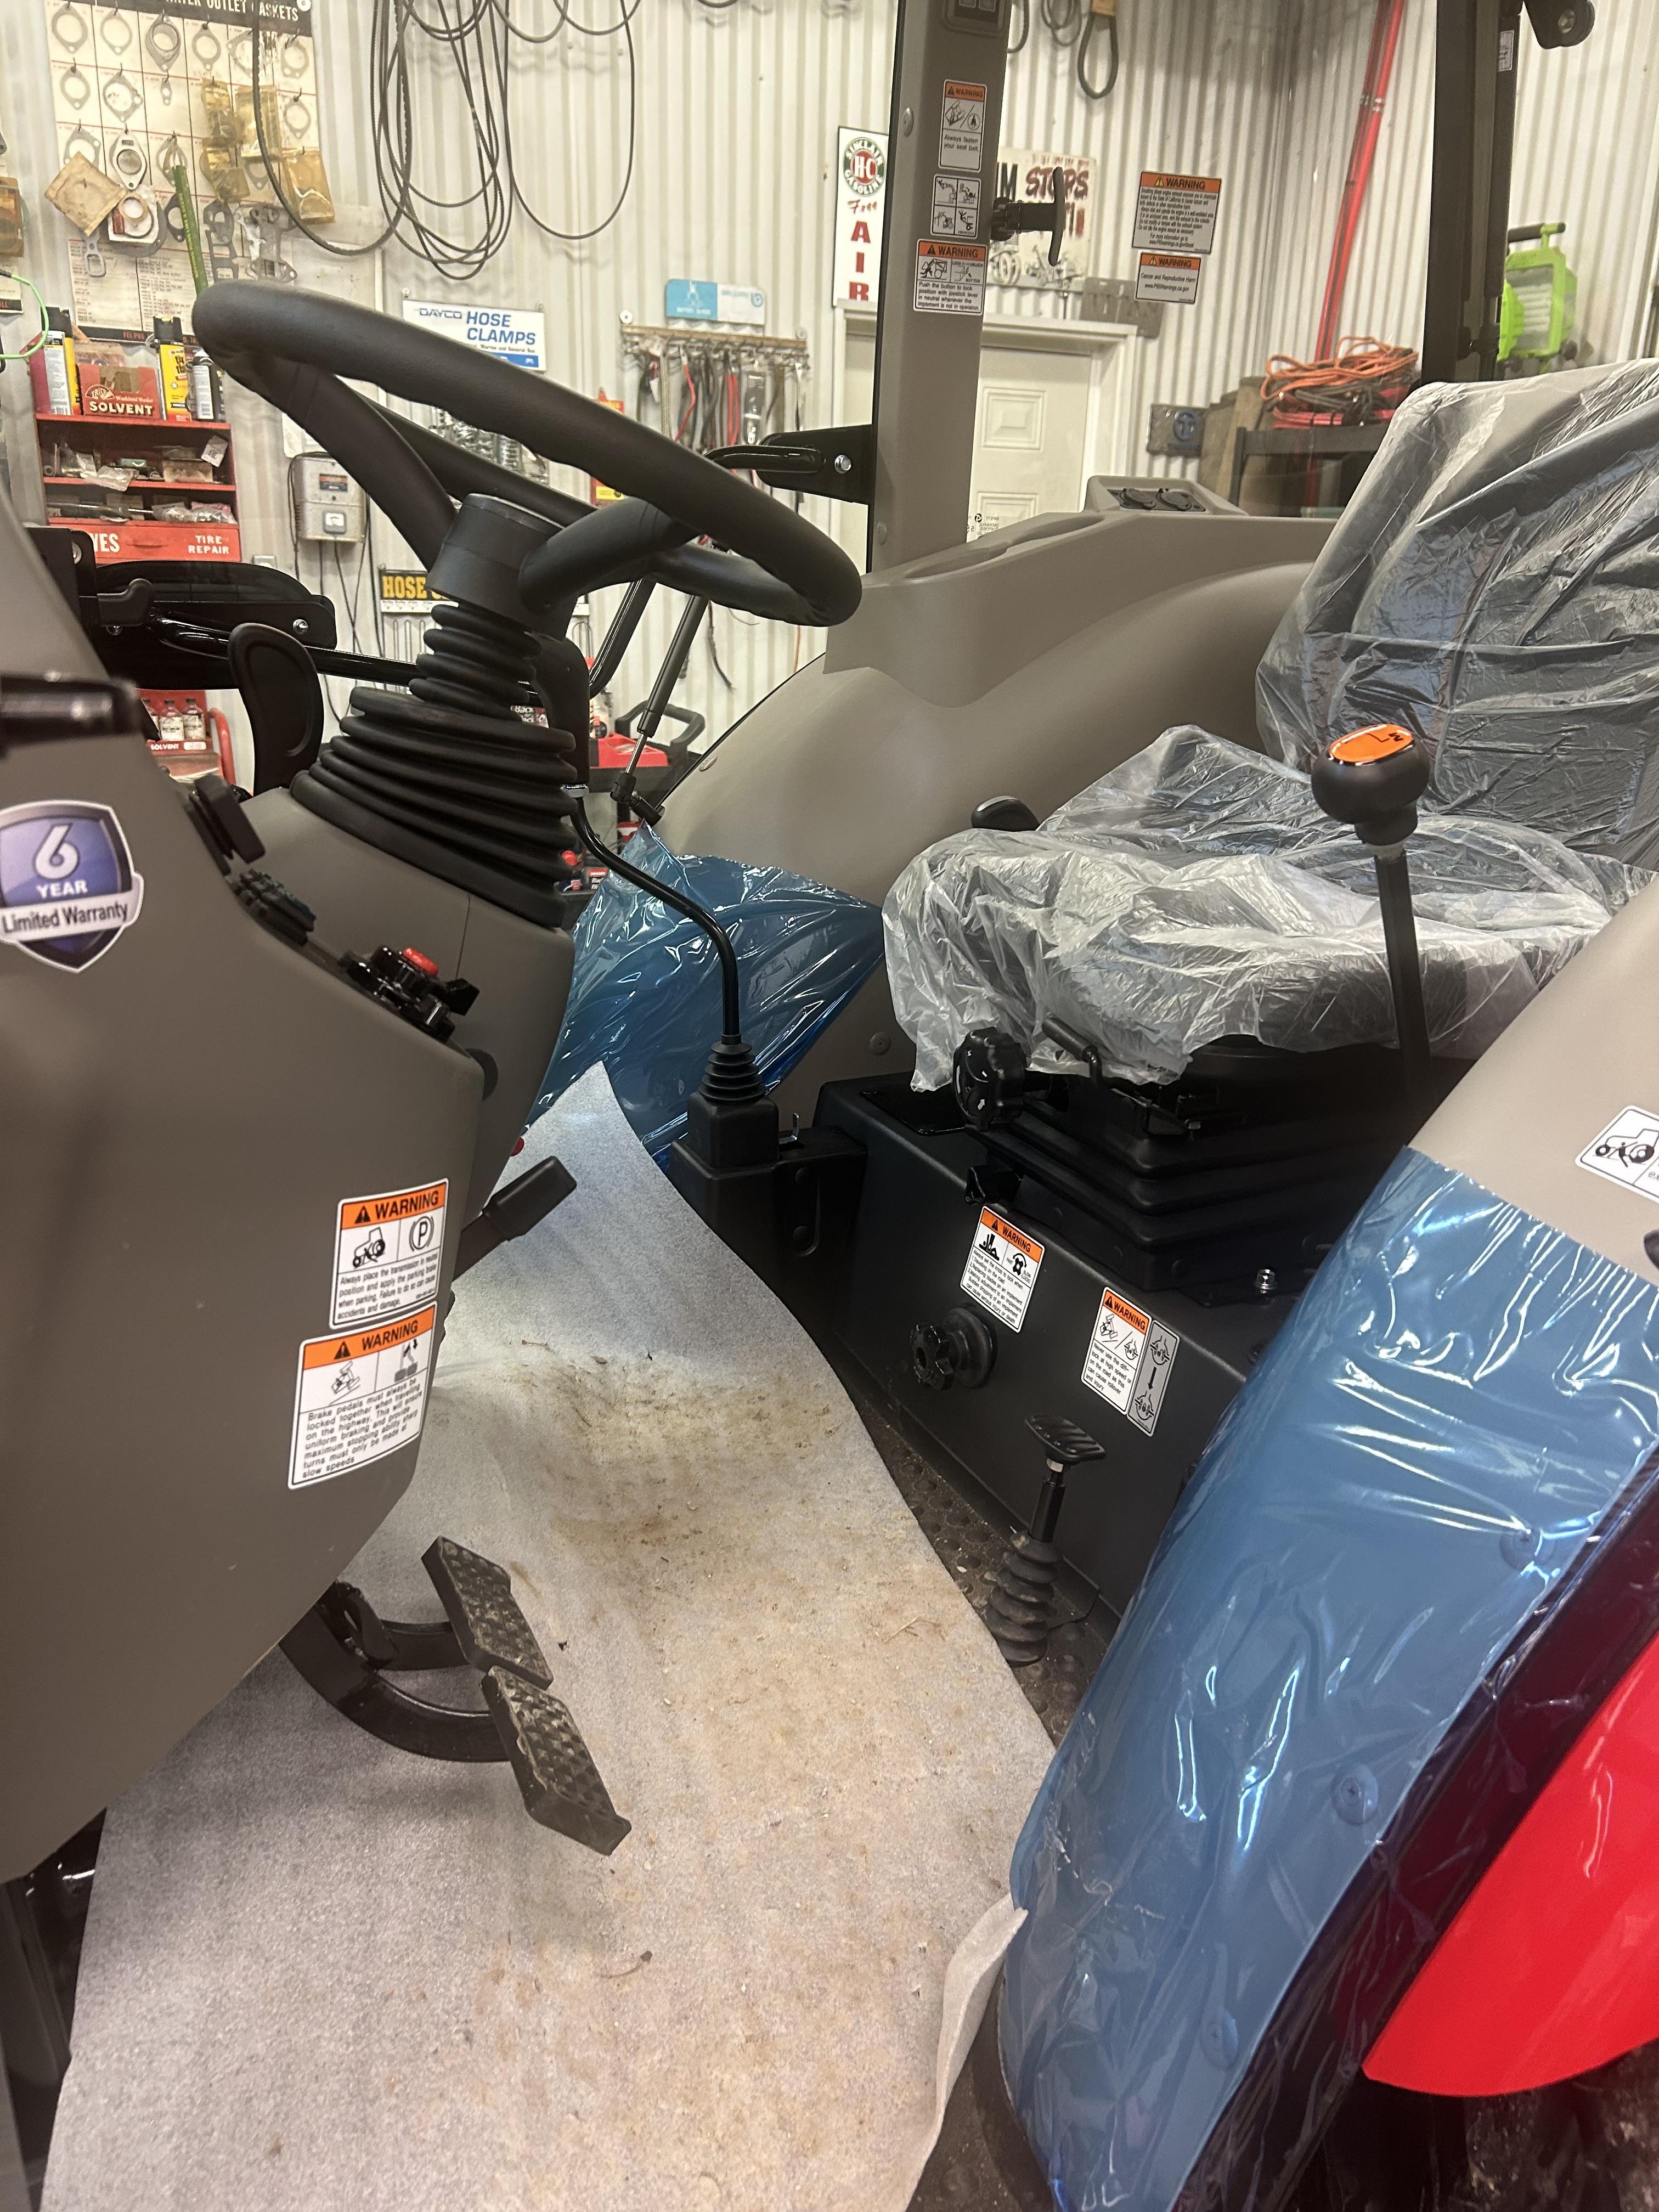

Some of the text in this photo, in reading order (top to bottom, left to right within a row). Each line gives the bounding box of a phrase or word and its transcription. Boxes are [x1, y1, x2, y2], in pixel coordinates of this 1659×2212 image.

[251, 2, 298, 21] ASKETS
[956, 88, 983, 98] WARNING
[944, 134, 961, 143] Always
[846, 140, 883, 166] SINCLAIR
[844, 169, 883, 194] GASOLINE
[1166, 177, 1205, 190] WARNING
[848, 199, 877, 214] Free
[939, 246, 978, 258] WARNING
[1159, 257, 1192, 268] WARNING
[419, 308, 511, 328] DAYCO HOSE
[467, 327, 535, 345] CLAMPS
[89, 401, 153, 415] SOLVENT
[188, 545, 229, 554] REPAIR
[195, 535, 222, 544] TIRE
[382, 576, 427, 599] HOSE
[35, 825, 78, 879] 6
[36, 879, 88, 899] YEAR
[2, 901, 128, 933] Limited Warranty
[375, 1190, 439, 1220] WARNING
[1002, 1226, 1031, 1253] WARNING
[973, 1250, 983, 1260] Always
[340, 1286, 365, 1297] position
[367, 1281, 378, 1291] and
[381, 1277, 395, 1288] apply
[407, 1268, 424, 1282] parking
[341, 1276, 361, 1285] Always
[363, 1272, 378, 1282] place
[381, 1268, 389, 1277] the
[339, 1299, 354, 1308] when
[969, 1276, 979, 1287] Sudden
[1002, 1304, 1018, 1318] implement
[1006, 1298, 1022, 1313] implement
[1007, 1291, 1022, 1305] implement
[338, 1308, 365, 1319] accidents
[368, 1303, 378, 1313] and
[981, 1295, 991, 1306] serious
[992, 1304, 1001, 1313] injury
[1006, 1314, 1015, 1324] death
[1114, 1301, 1146, 1331] WARNING
[362, 1320, 418, 1351] WARNING
[1094, 1342, 1104, 1354] Never
[1103, 1369, 1111, 1378] road
[1105, 1361, 1113, 1370] high
[1115, 1369, 1126, 1380] speed
[1094, 1379, 1104, 1391] injury
[1096, 1373, 1107, 1383] cause
[1108, 1381, 1121, 1394] rollover
[308, 1378, 416, 1420] Brake pedals must always be
[306, 1432, 317, 1440] on
[321, 1427, 335, 1436] the
[377, 1408, 390, 1418] This
[307, 1398, 392, 1430] locked together when
[306, 1436, 337, 1450] uniform
[341, 1425, 370, 1440] braking
[373, 1417, 386, 1429] and
[304, 1443, 343, 1459] maximum
[347, 1430, 379, 1447] stopping
[304, 1458, 325, 1469] turns
[330, 1449, 349, 1460] must
[352, 1442, 368, 1454] only
[371, 1438, 380, 1447] be
[382, 1429, 398, 1441] made
[303, 1456, 354, 1478] slow speeds
